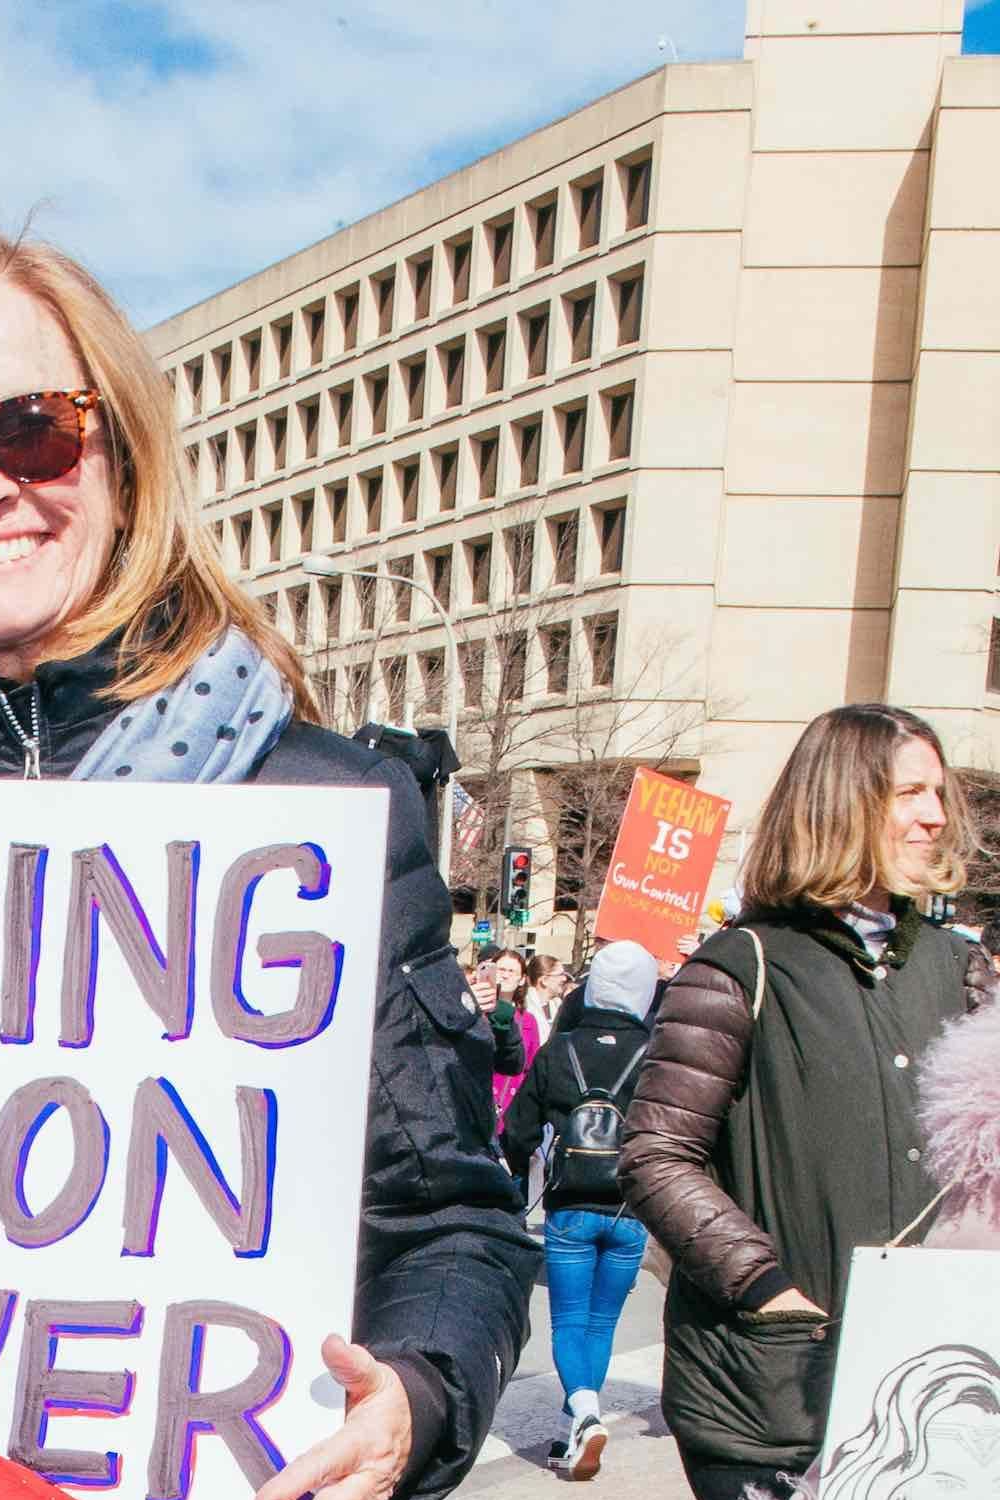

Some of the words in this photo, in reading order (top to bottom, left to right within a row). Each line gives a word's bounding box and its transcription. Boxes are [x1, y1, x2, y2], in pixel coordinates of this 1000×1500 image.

[637, 776, 722, 836] YEEHAW
[649, 820, 693, 860] IS
[643, 852, 682, 879] NOT
